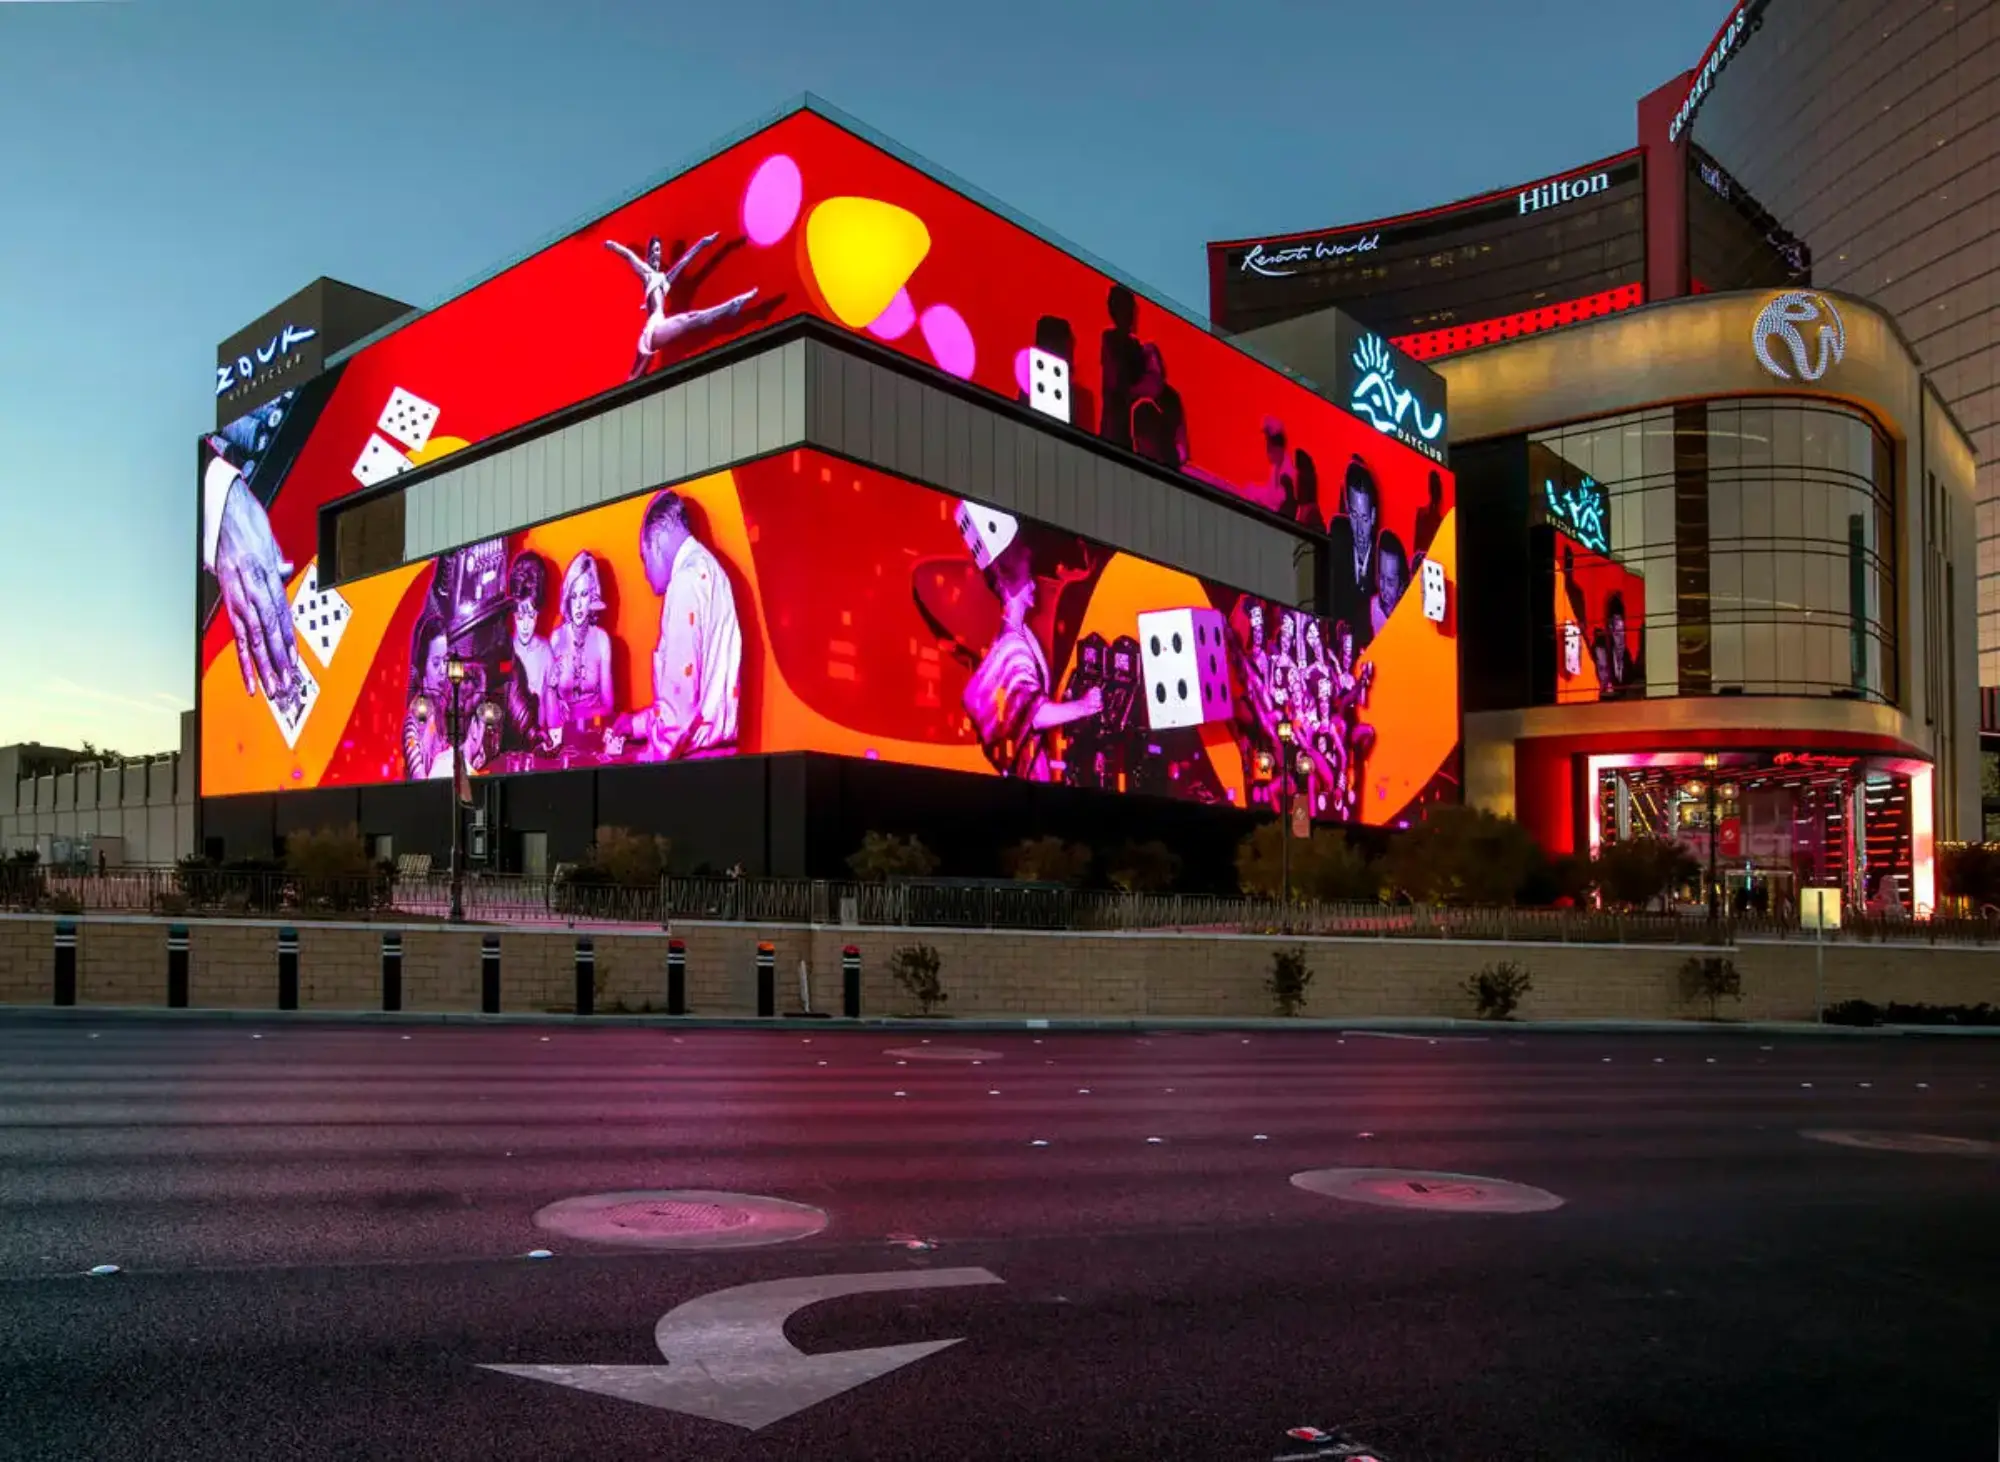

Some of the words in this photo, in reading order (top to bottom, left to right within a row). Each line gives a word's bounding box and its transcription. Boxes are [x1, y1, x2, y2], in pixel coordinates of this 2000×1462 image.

[1669, 8, 1744, 142] CROCKFORDS
[1519, 172, 1609, 214] Hilton
[1241, 244, 1312, 276] Resorts
[1316, 234, 1380, 258] World
[216, 324, 316, 395] ZOUK
[1397, 427, 1442, 462] DAYCLUB
